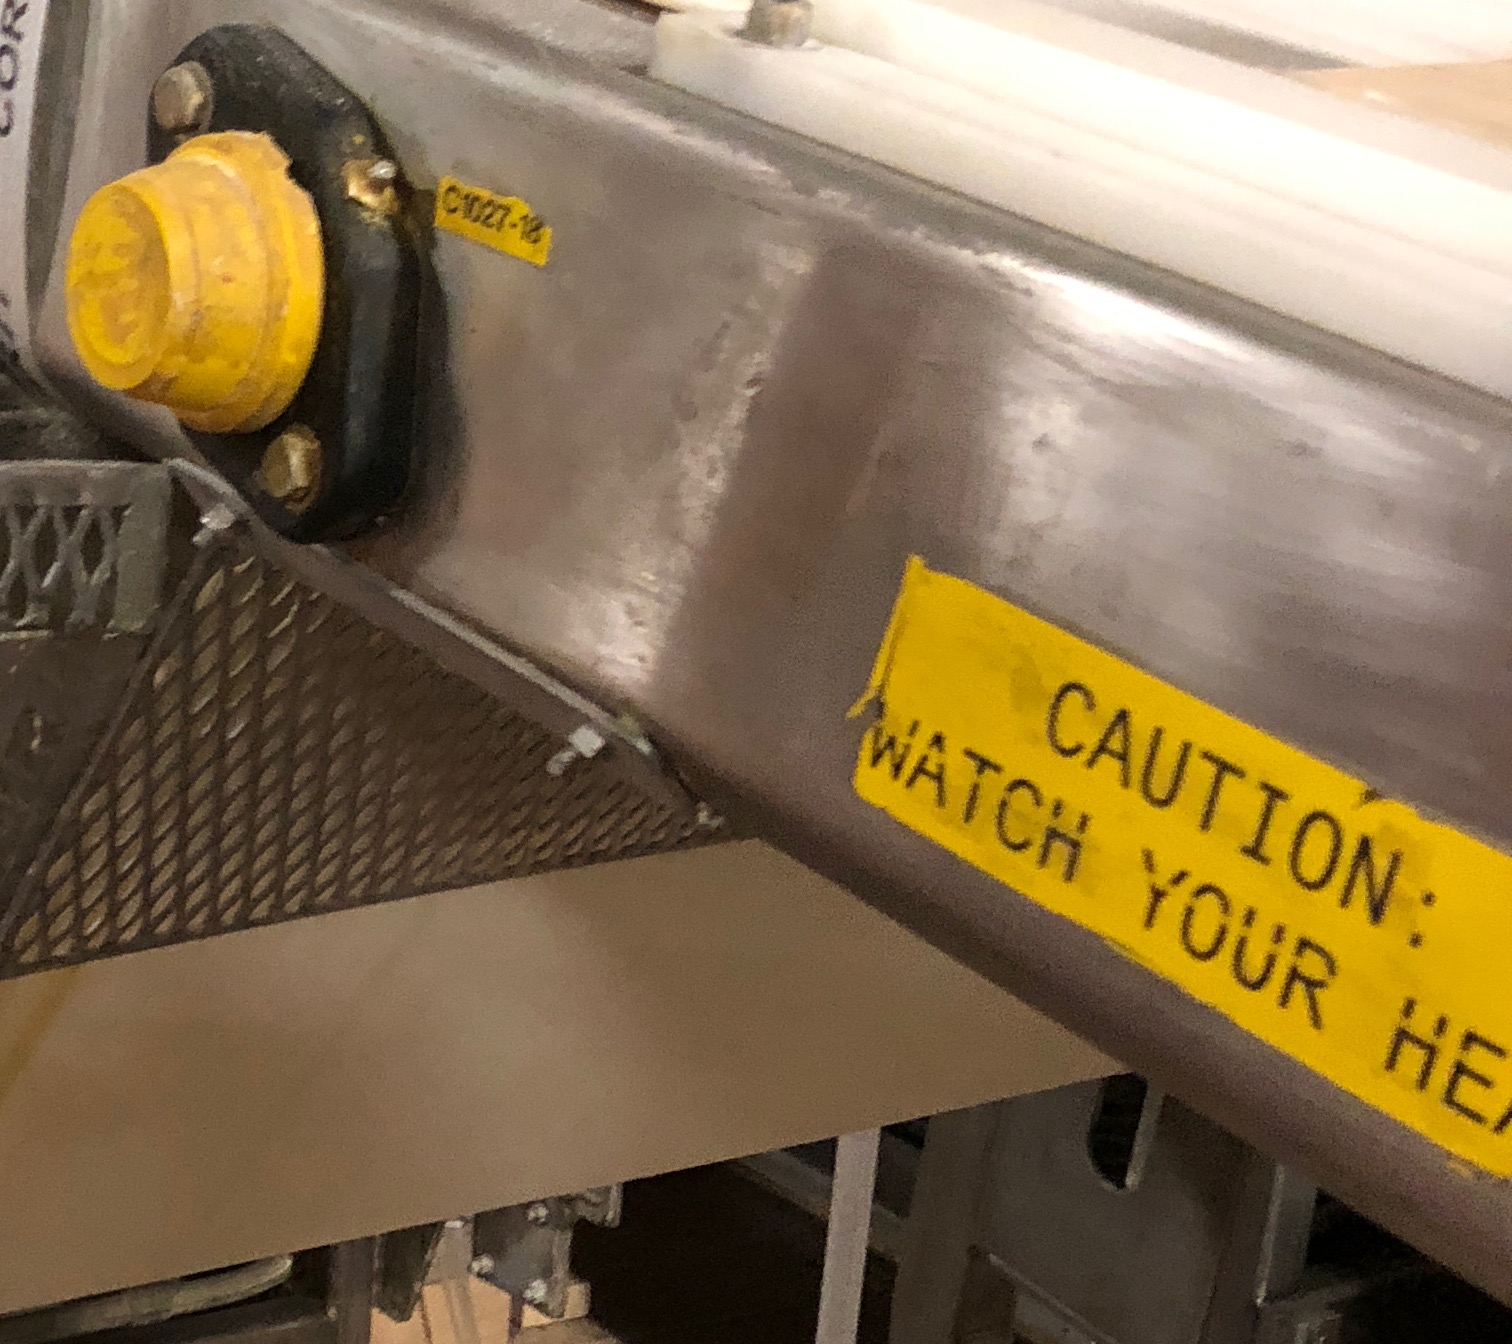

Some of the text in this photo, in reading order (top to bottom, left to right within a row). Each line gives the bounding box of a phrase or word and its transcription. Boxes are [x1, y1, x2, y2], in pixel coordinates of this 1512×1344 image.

[867, 717, 1092, 884] WATCH
[1138, 846, 1337, 1031] YOUR
[1044, 680, 1437, 949] CAUTION:
